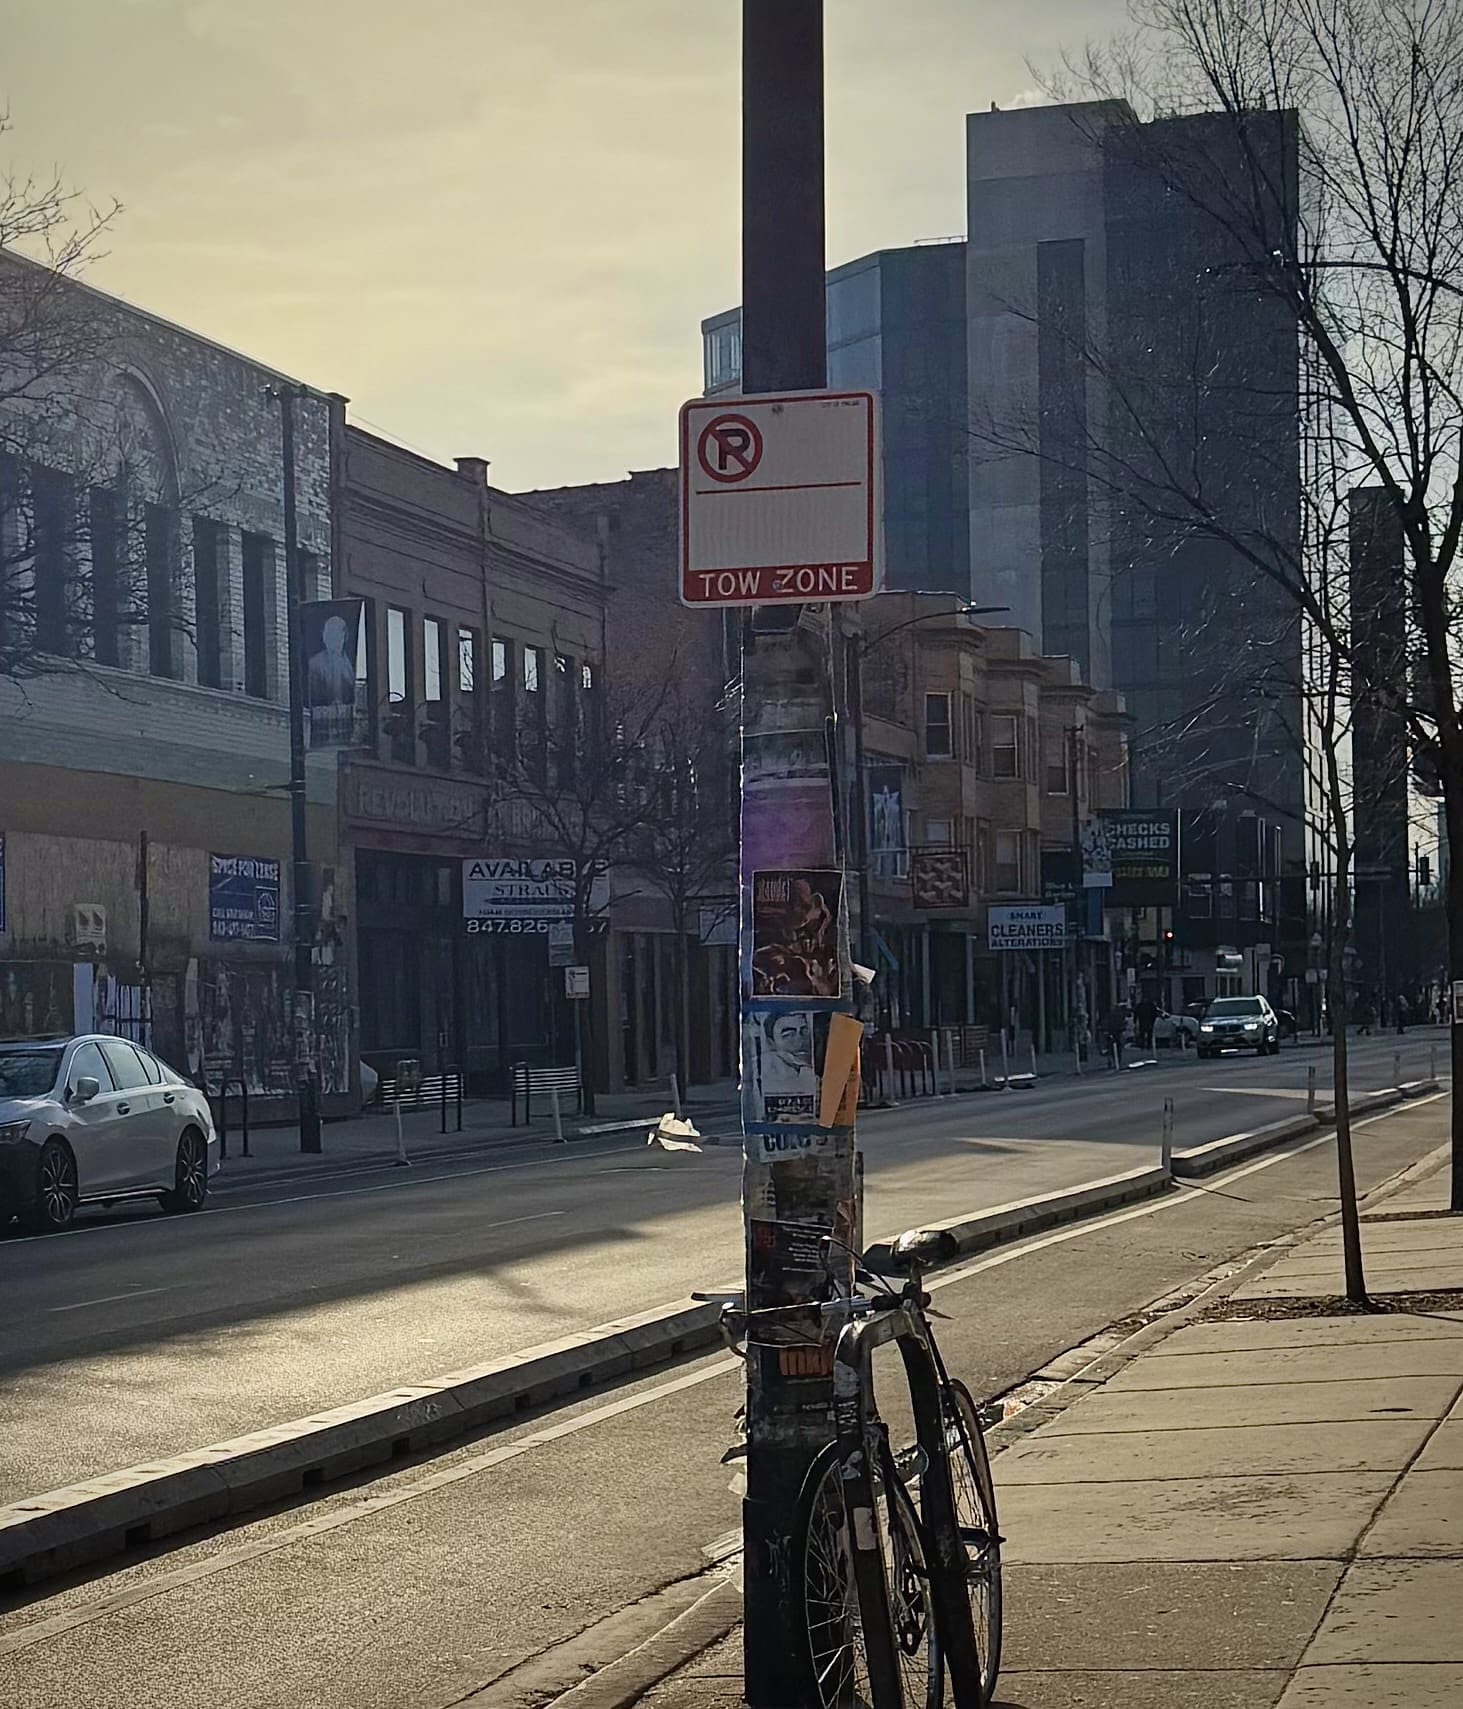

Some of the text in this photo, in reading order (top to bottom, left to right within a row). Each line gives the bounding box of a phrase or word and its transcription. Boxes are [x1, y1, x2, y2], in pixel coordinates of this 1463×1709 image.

[699, 566, 859, 598] TOW ZONE
[469, 860, 608, 878] AVAILABE
[991, 923, 1063, 937] CLEANERS
